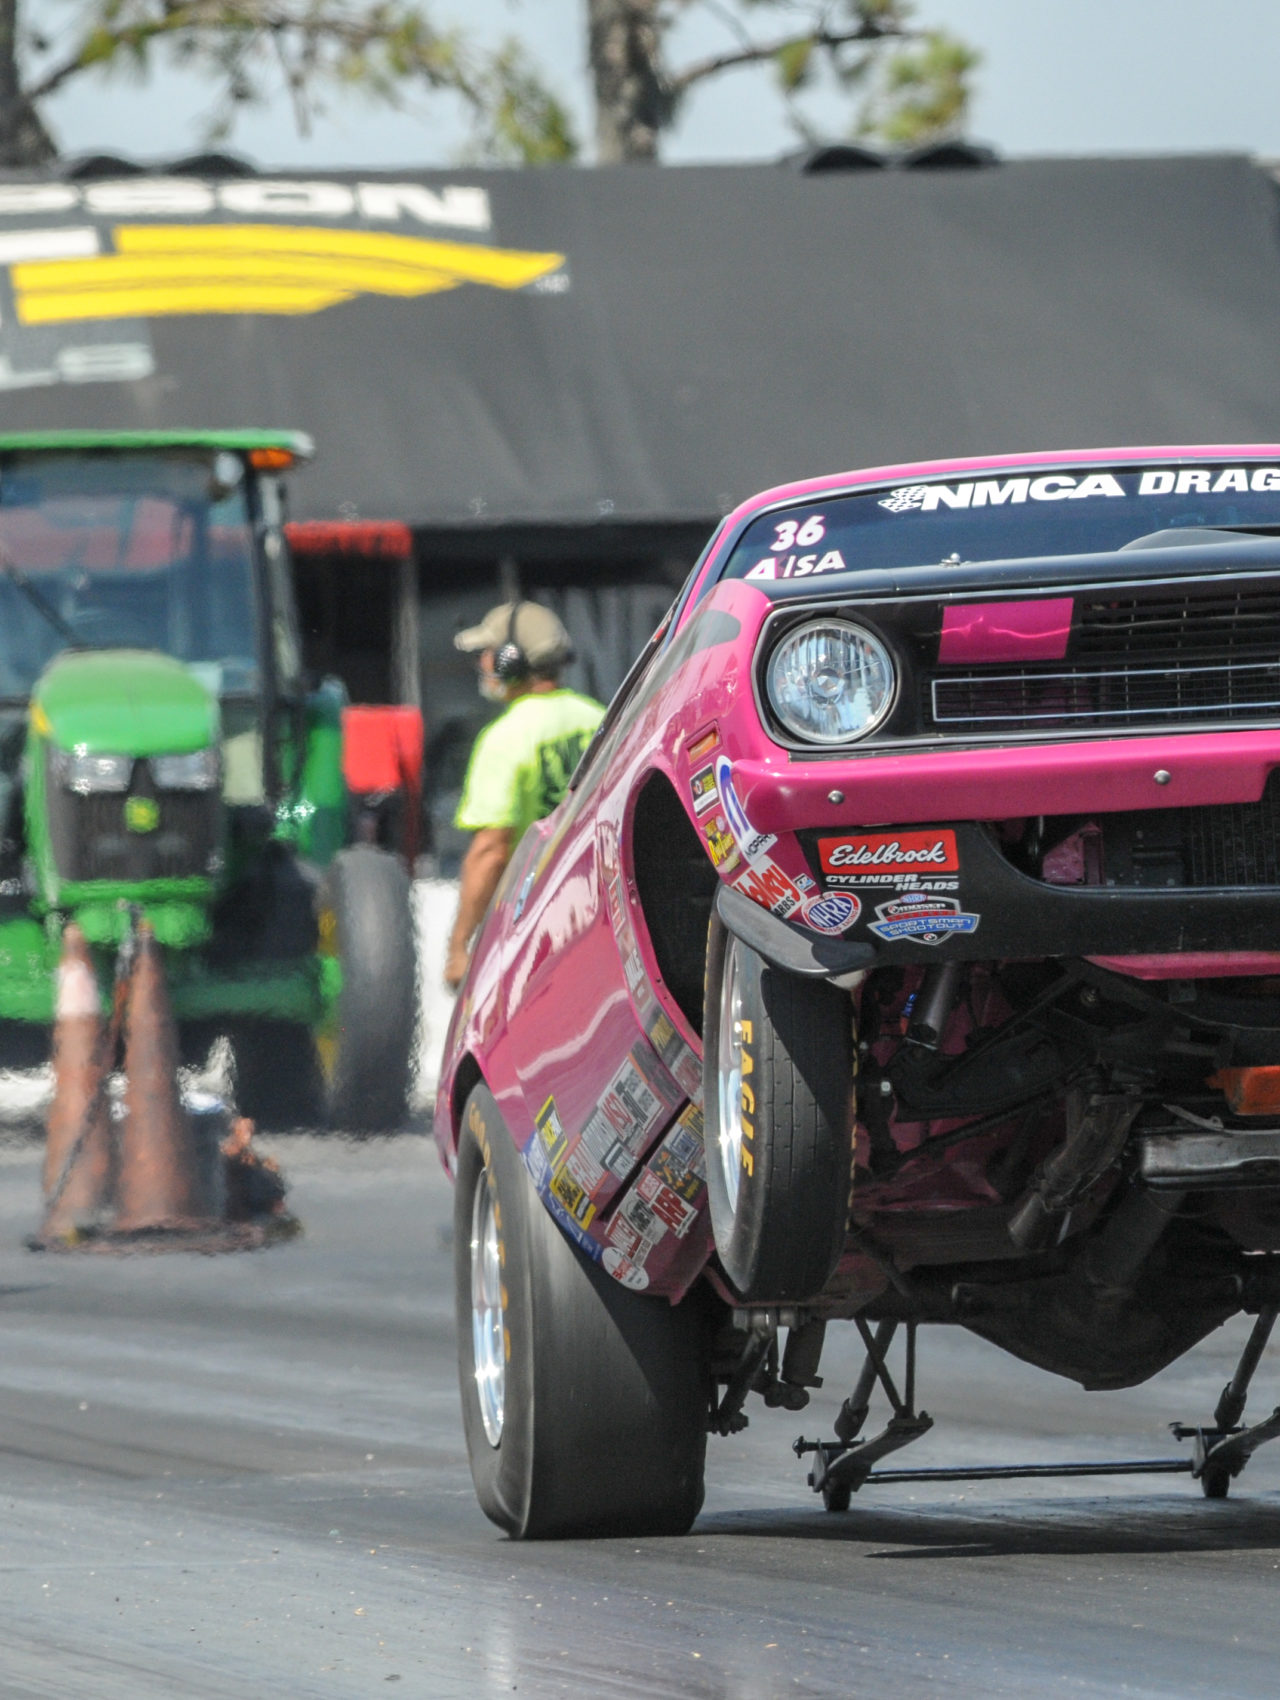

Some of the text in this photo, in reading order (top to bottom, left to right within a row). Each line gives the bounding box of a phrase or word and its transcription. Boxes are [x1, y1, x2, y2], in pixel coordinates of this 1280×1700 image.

[920, 474, 1126, 511] NMCA
[769, 515, 826, 552] 36
[828, 842, 946, 867] Edelbrock
[826, 874, 918, 884] CYLINDER
[895, 882, 959, 891] HEADS
[809, 898, 853, 929] NHRA
[740, 1019, 755, 1177] EAGLE
[650, 1186, 689, 1233] ARP
